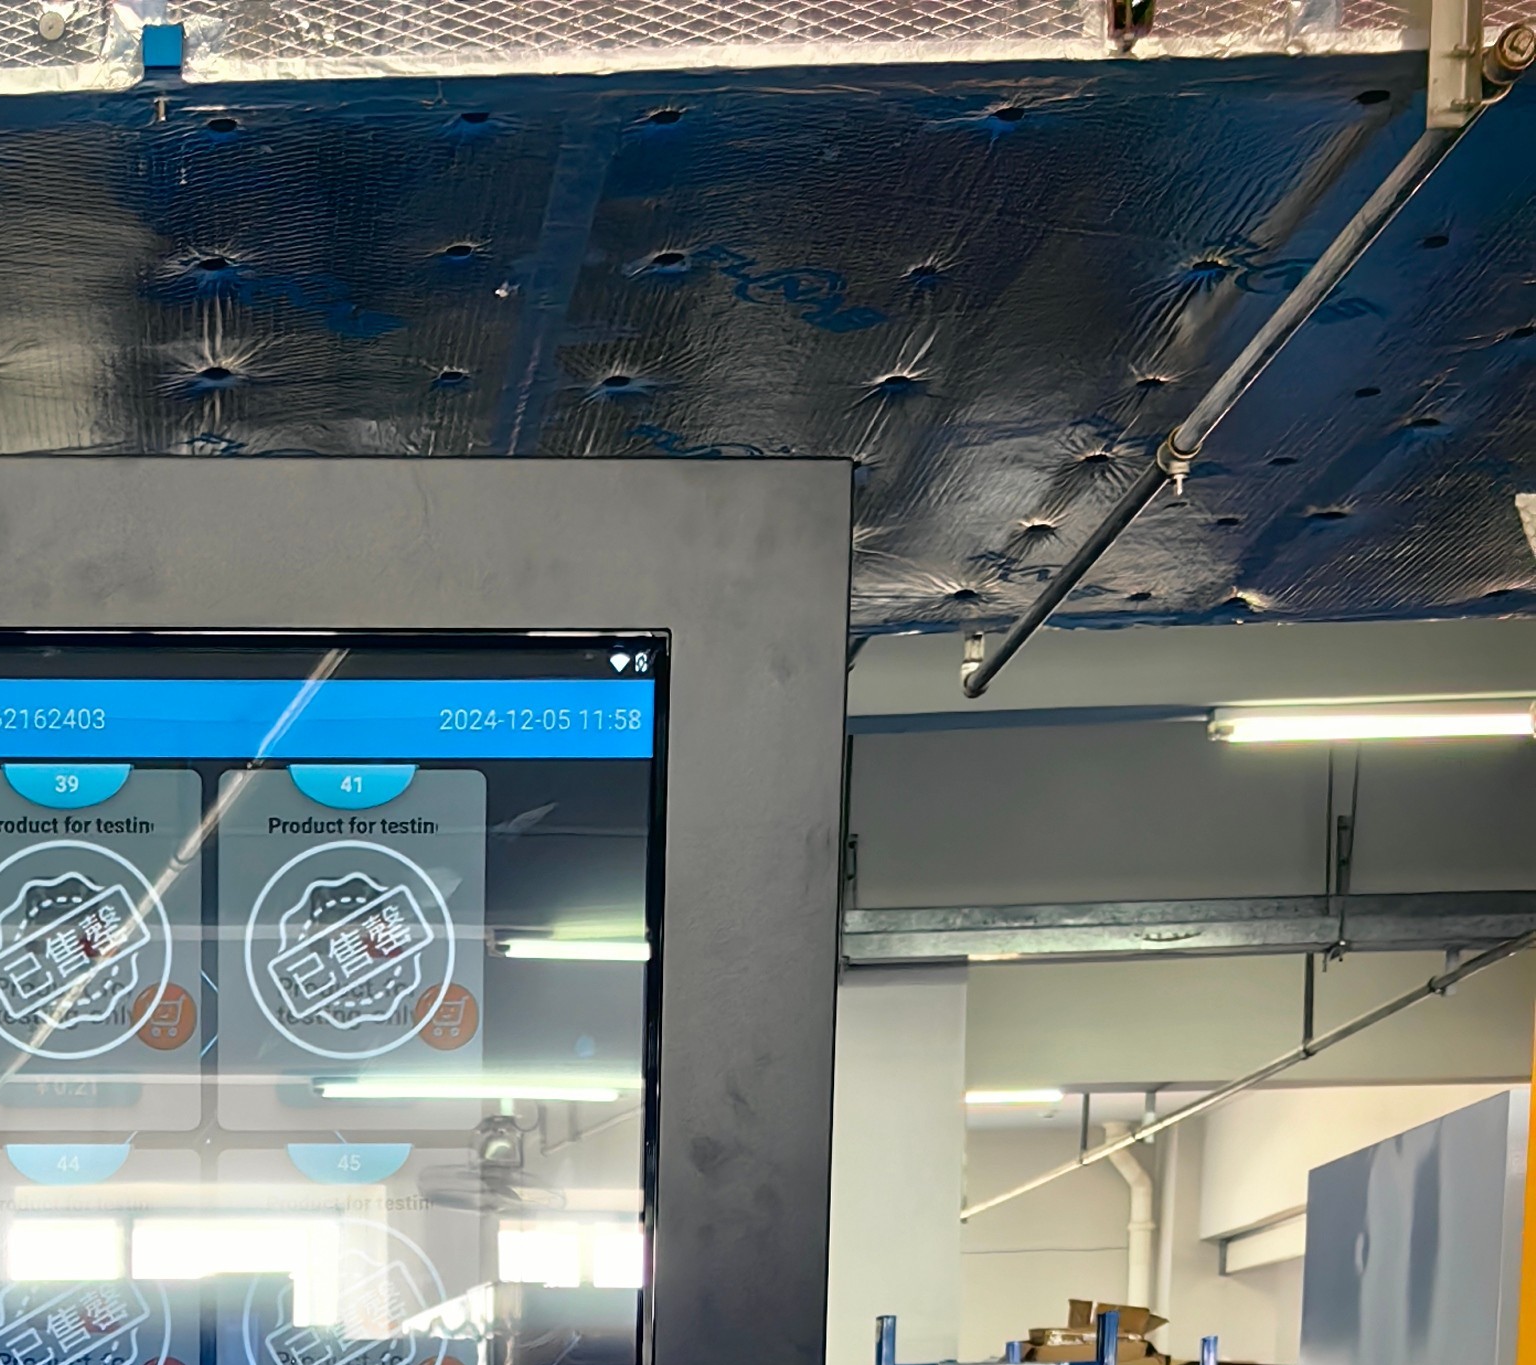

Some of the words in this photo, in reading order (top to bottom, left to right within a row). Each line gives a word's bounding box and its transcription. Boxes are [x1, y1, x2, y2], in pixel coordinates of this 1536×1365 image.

[439, 708, 571, 731] 2024-12-05
[578, 709, 642, 730] 11:58
[55, 775, 79, 793] 39
[340, 776, 363, 793] 41
[64, 816, 91, 833] for
[96, 817, 154, 833] testin
[269, 817, 344, 833] Product
[349, 817, 376, 833] for
[381, 817, 438, 833] testin
[0, 904, 128, 996] 已售罄
[284, 905, 411, 996] 已售罄
[57, 1155, 80, 1172] 44
[337, 1155, 361, 1171] 45
